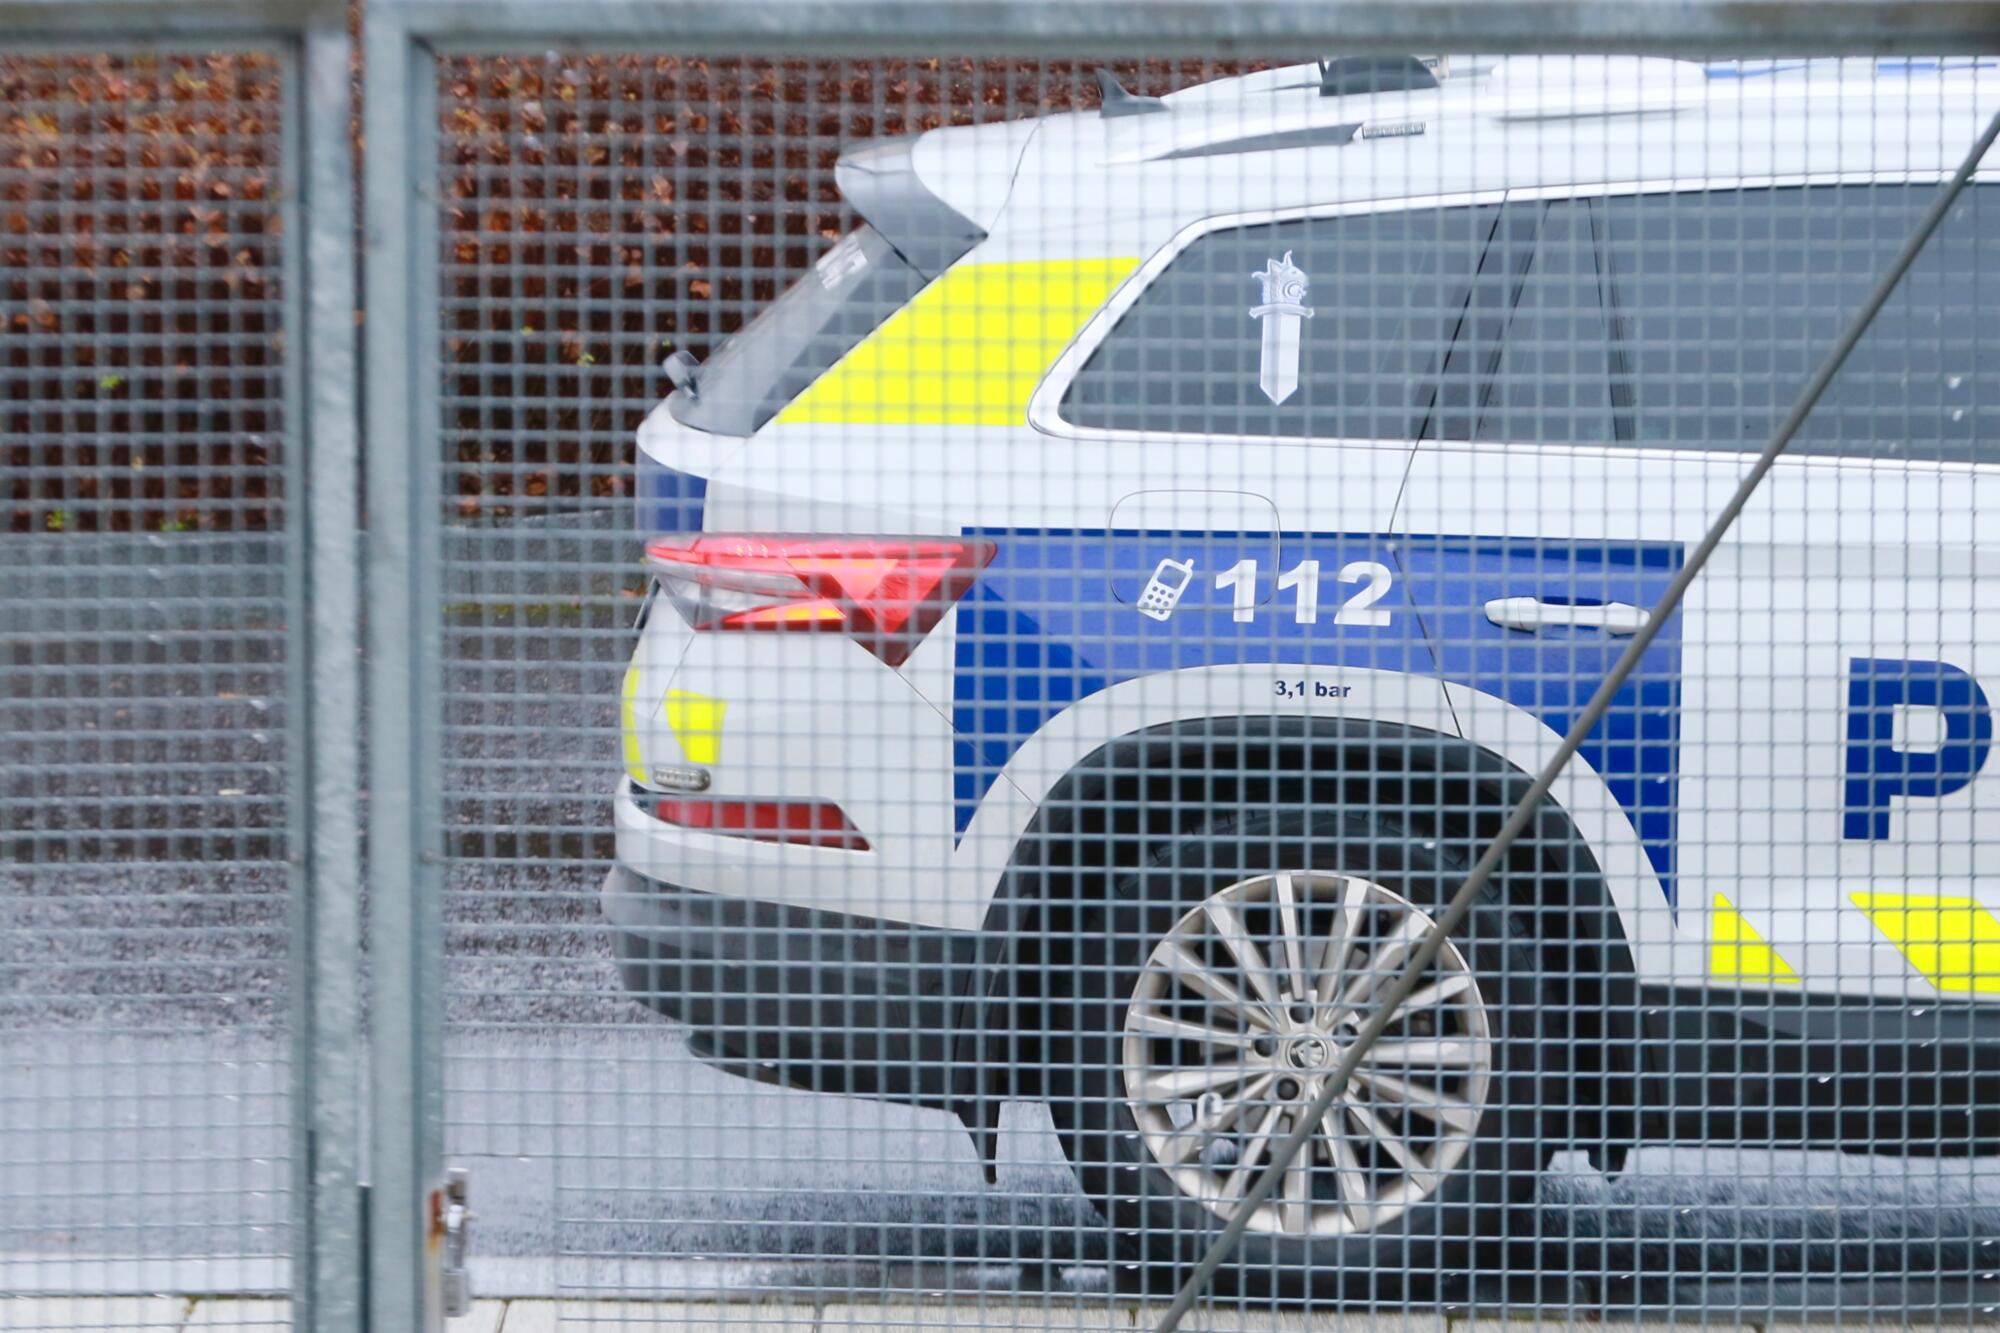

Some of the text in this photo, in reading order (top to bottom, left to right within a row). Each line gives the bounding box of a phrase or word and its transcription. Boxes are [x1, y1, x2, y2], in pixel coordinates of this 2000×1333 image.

[1215, 559, 1393, 626] 112
[1275, 680, 1351, 699] 3,1 bar
[1843, 657, 1992, 840] P
